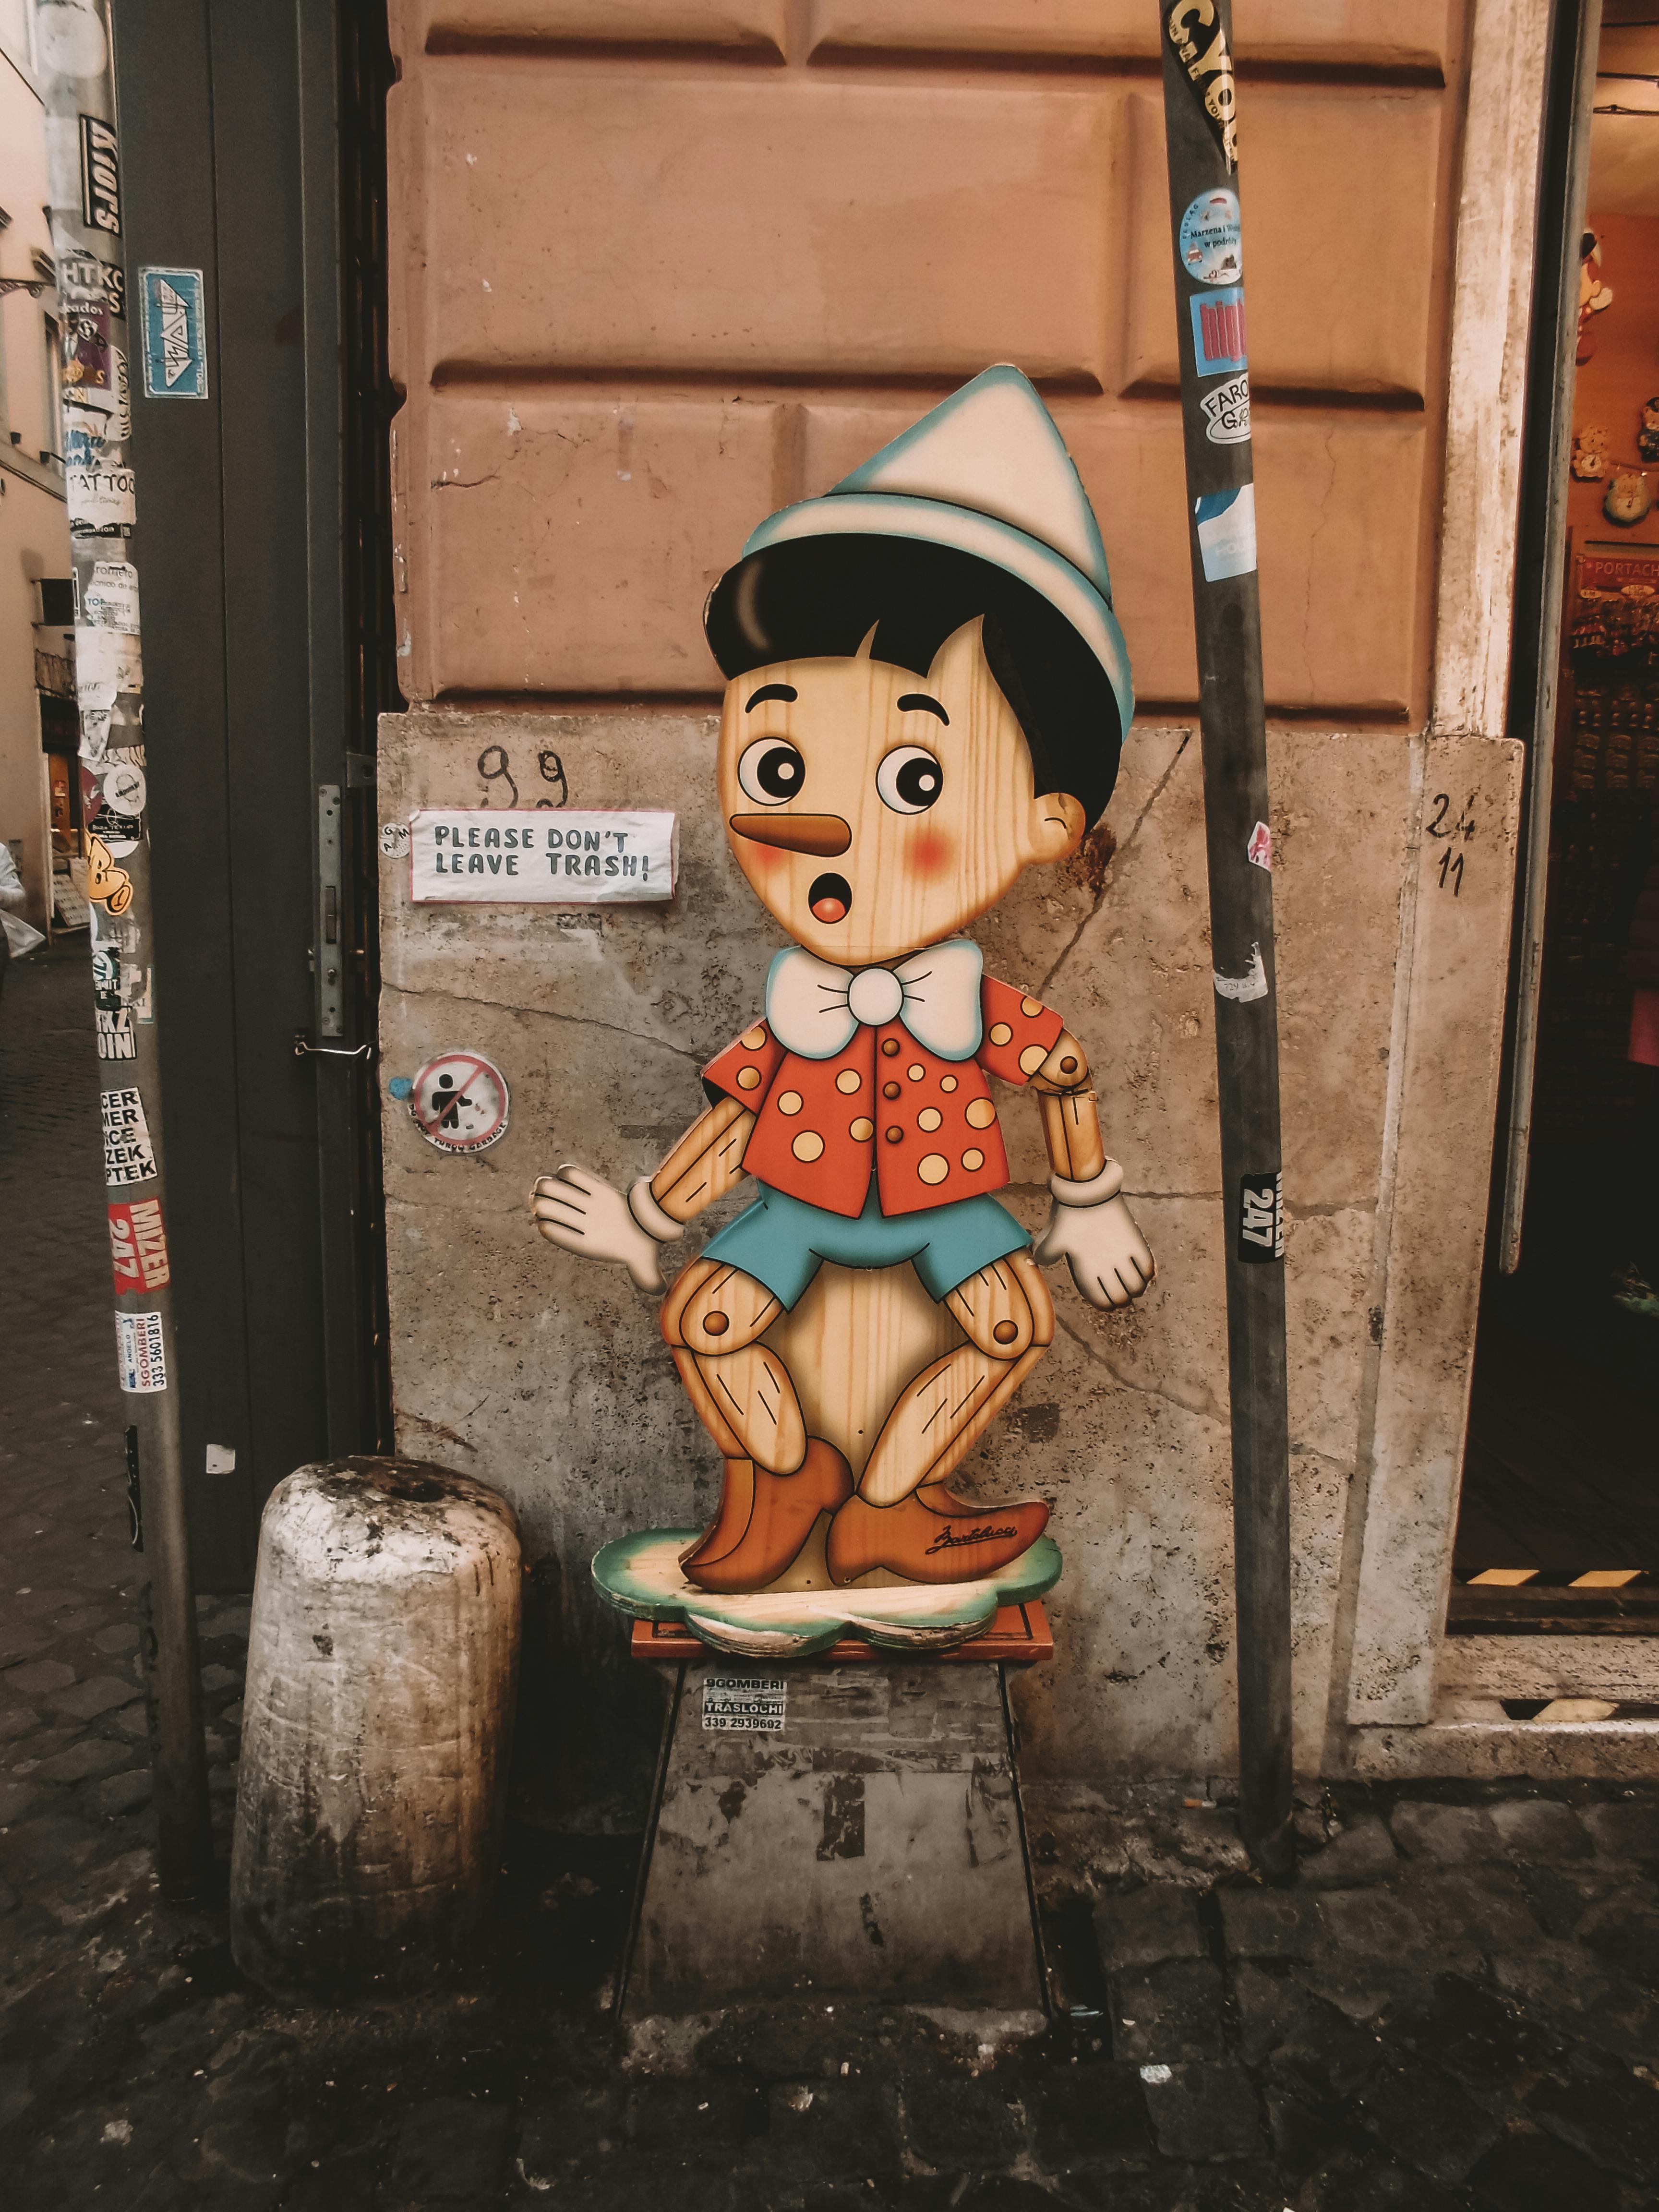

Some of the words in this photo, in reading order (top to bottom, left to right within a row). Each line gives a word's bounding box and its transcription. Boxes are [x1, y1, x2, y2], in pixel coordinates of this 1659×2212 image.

[1190, 227, 1222, 239] Marzena
[434, 825, 534, 849] PLEASE
[548, 828, 628, 853] DON'T
[436, 852, 519, 877] LEAVE
[545, 852, 649, 881] TRASH!
[1242, 1189, 1274, 1247] 247
[109, 1218, 140, 1278] 247
[129, 1199, 170, 1288] MIZER
[135, 1318, 151, 1387] SGOMBERI
[146, 1314, 162, 1362] 5601816
[151, 1365, 165, 1387] 333
[705, 1717, 727, 1728] 339
[706, 1702, 782, 1714] TRASLOCHI
